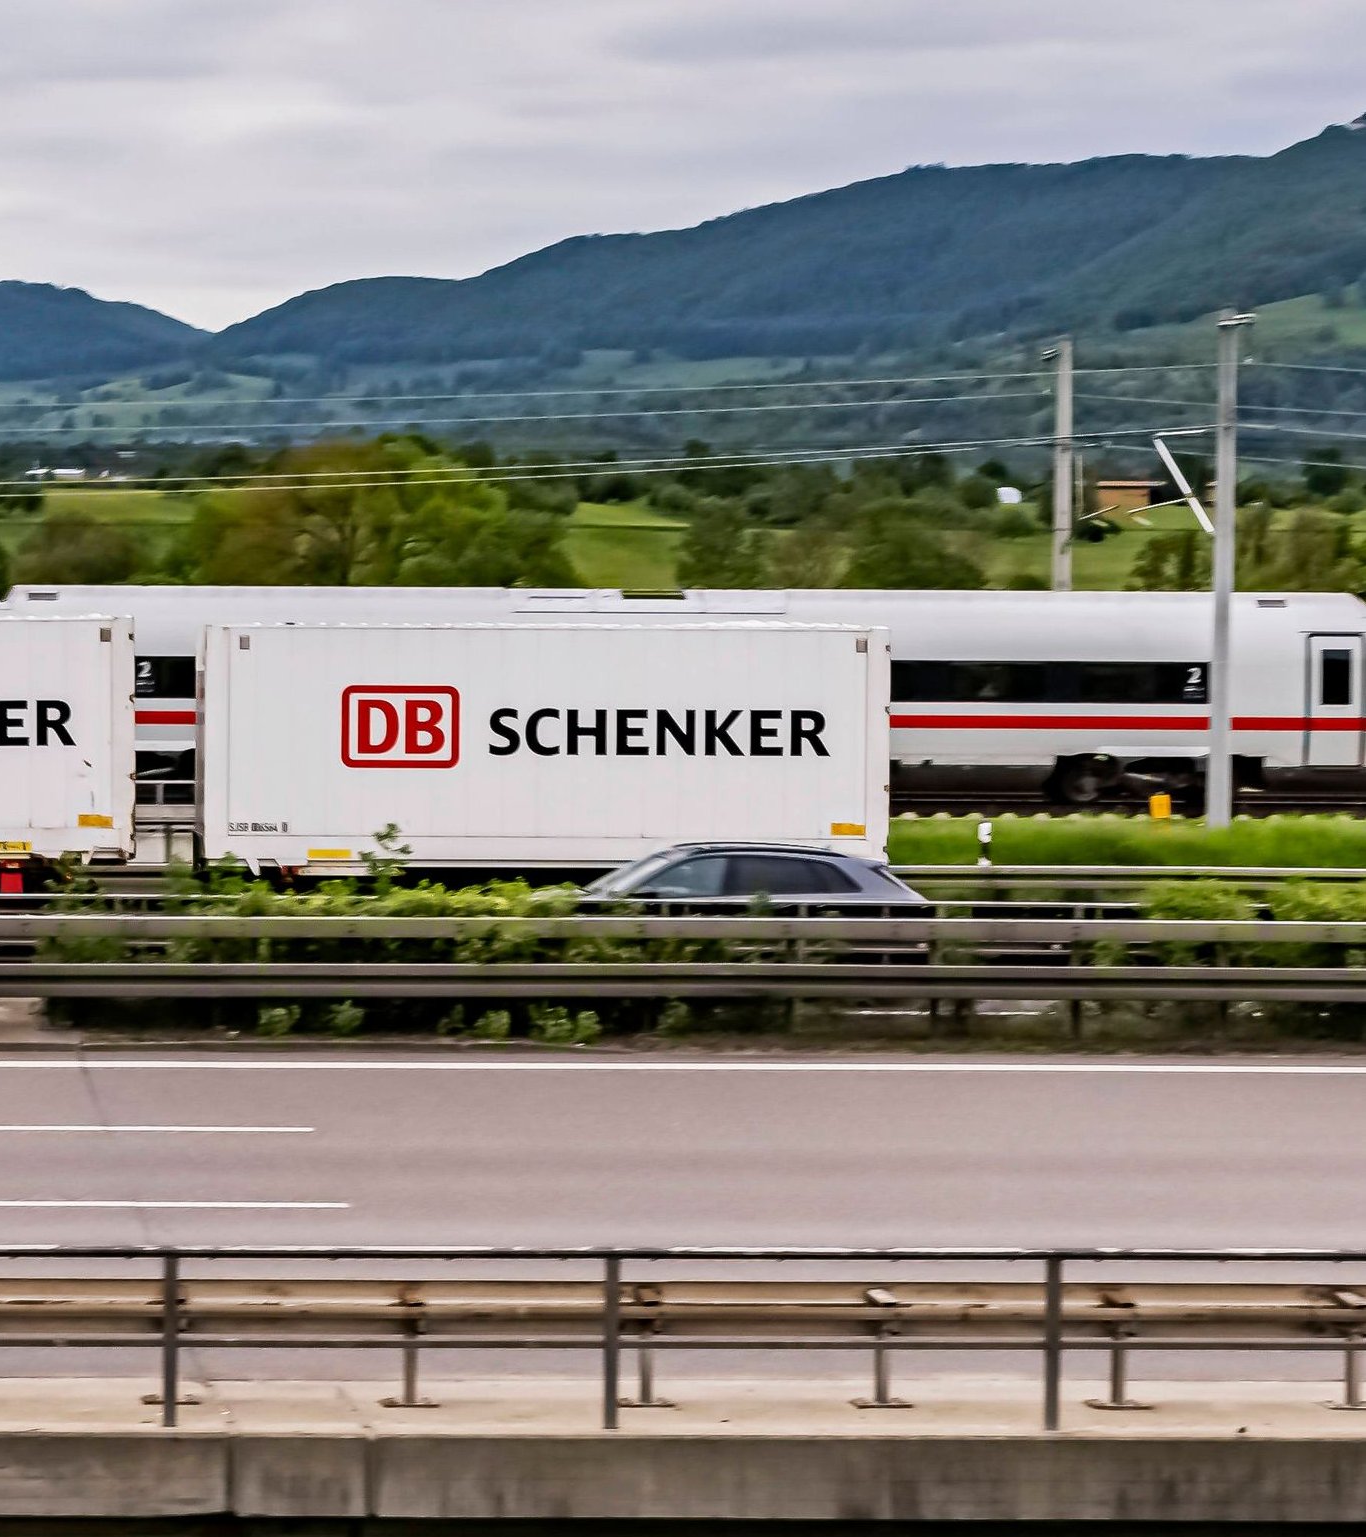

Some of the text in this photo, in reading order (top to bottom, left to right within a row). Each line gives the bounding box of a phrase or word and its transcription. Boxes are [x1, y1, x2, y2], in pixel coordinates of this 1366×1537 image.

[137, 661, 152, 677] 2
[1187, 667, 1201, 683] 2
[356, 699, 831, 757] DB SCHENKER
